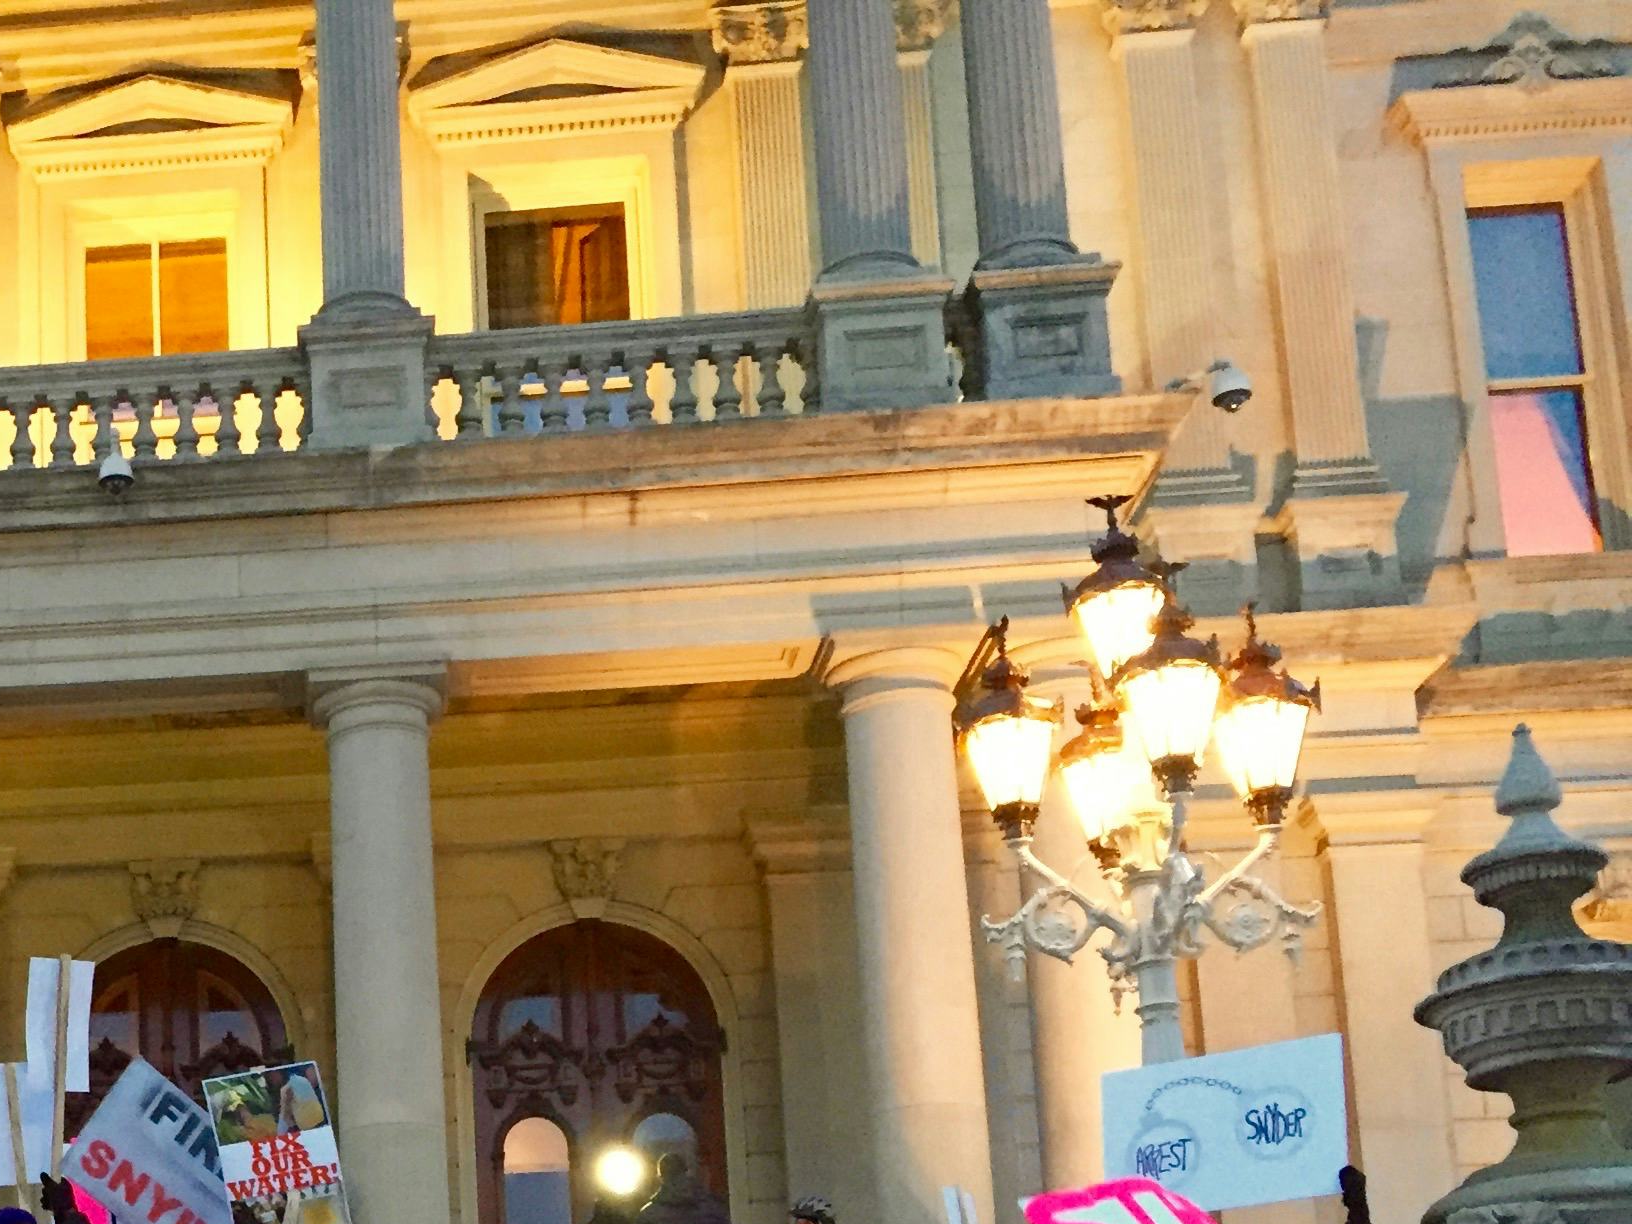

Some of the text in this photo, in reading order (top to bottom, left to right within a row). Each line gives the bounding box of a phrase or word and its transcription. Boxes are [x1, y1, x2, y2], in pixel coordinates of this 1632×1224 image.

[1245, 1102, 1307, 1145] SNYDER
[249, 1131, 305, 1160] FIX
[251, 1150, 312, 1176] OUR
[1136, 1139, 1192, 1180] ARREST
[227, 1163, 338, 1200] WATER!
